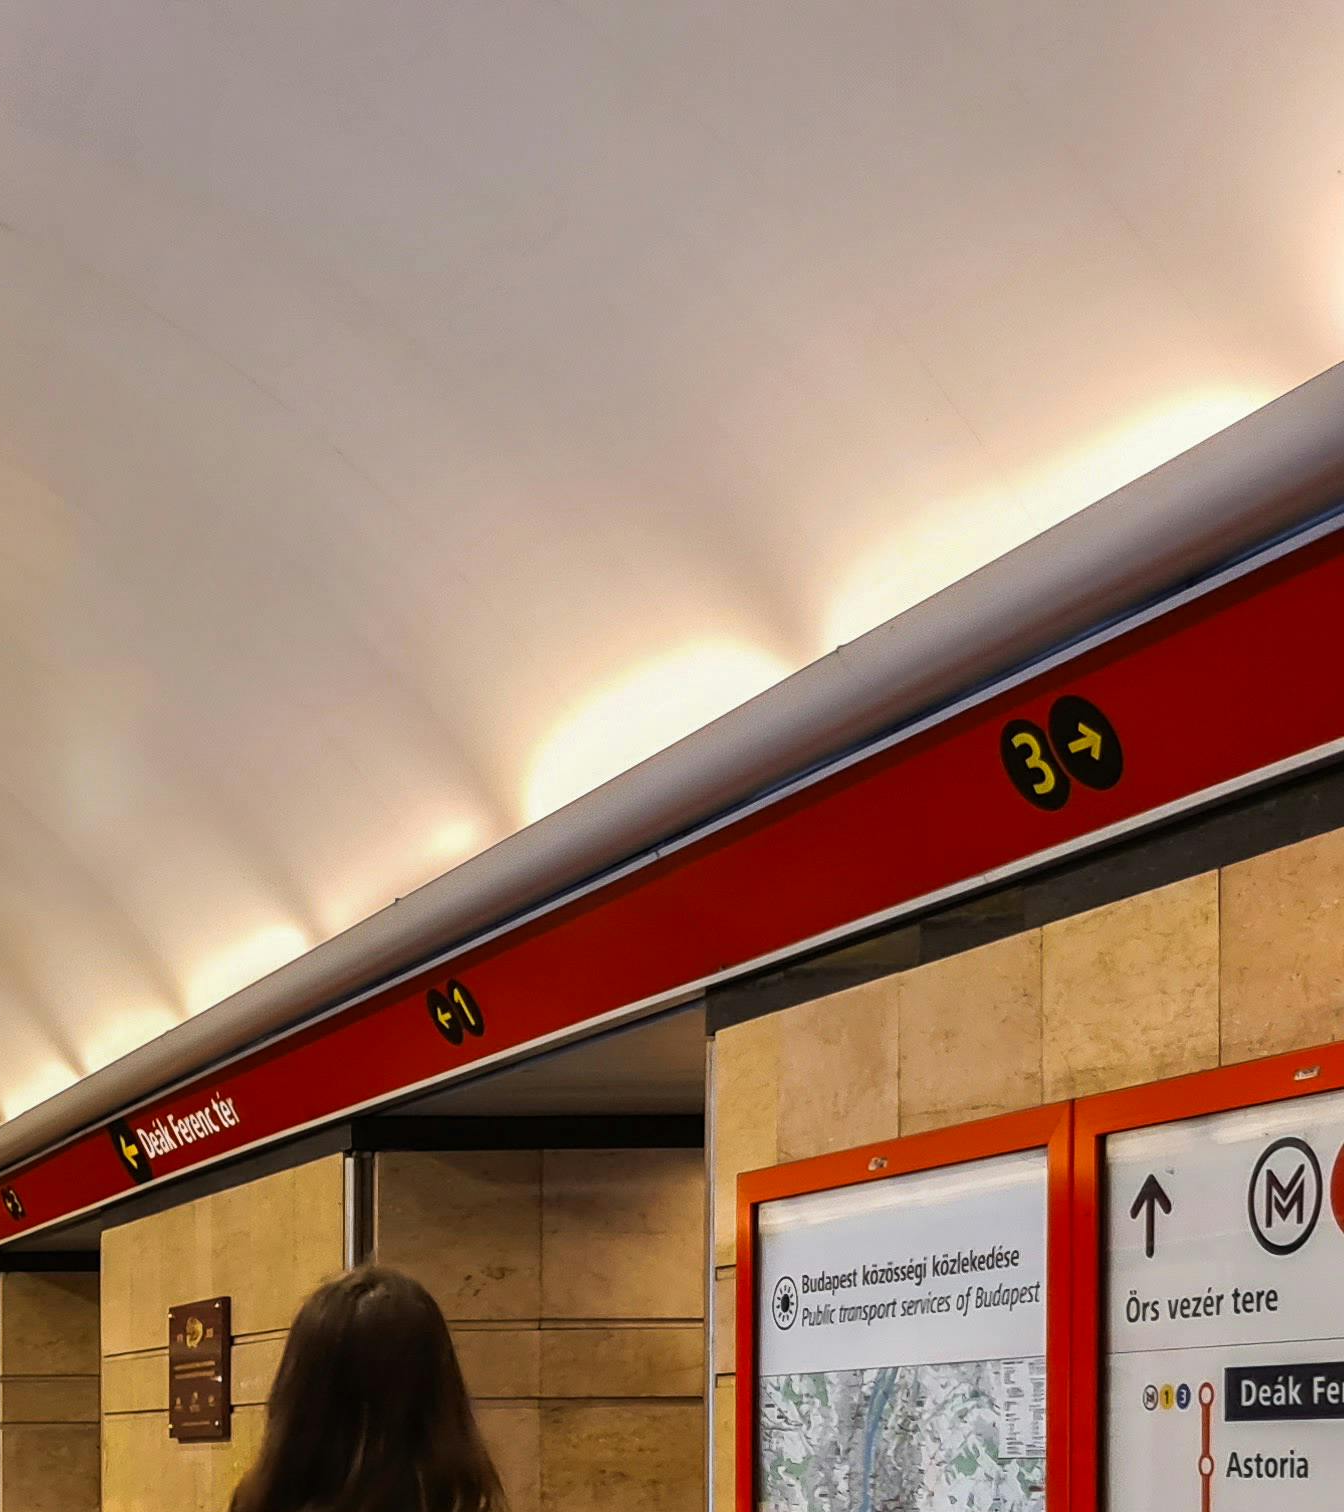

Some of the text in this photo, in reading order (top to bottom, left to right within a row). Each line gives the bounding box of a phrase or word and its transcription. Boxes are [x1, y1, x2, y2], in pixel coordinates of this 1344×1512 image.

[1011, 732, 1055, 794] 3
[453, 987, 476, 1026] 1
[136, 1090, 240, 1159] Deák Ferenc tér
[801, 1245, 1020, 1295] Budapest közösségi közlekedése
[801, 1281, 1041, 1328] Public transport services of Budapest
[1167, 1287, 1224, 1319] vezér
[1231, 1287, 1279, 1315] tere
[1240, 1376, 1303, 1407] Deák
[1226, 1450, 1309, 1478] Astoria
